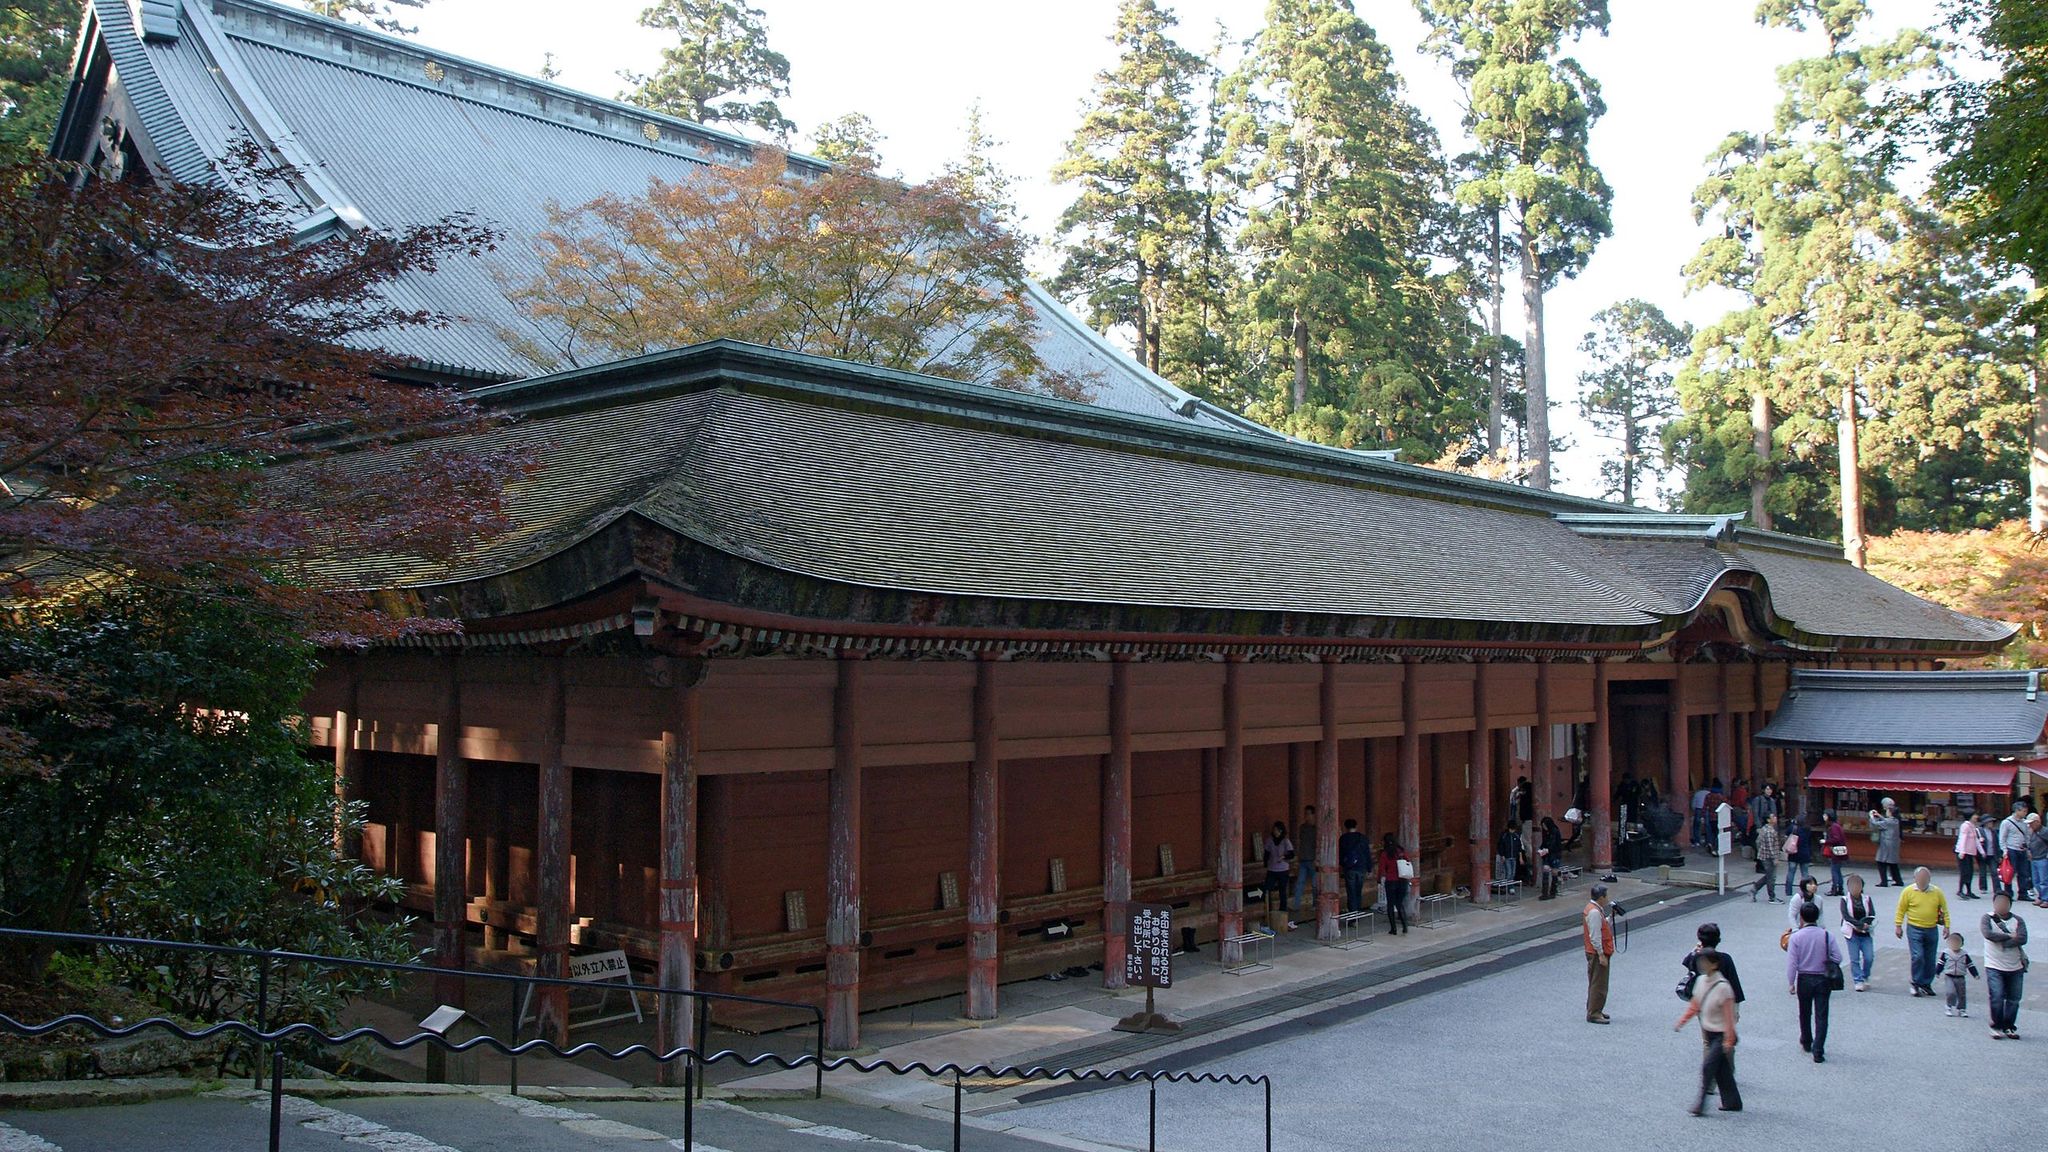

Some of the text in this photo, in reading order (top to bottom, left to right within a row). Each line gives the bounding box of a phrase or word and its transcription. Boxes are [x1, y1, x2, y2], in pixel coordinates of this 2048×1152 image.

[1142, 909, 1151, 949] 受付所に
[1151, 917, 1160, 976] お参りの前に
[1160, 911, 1169, 984] 朱印をされる方は
